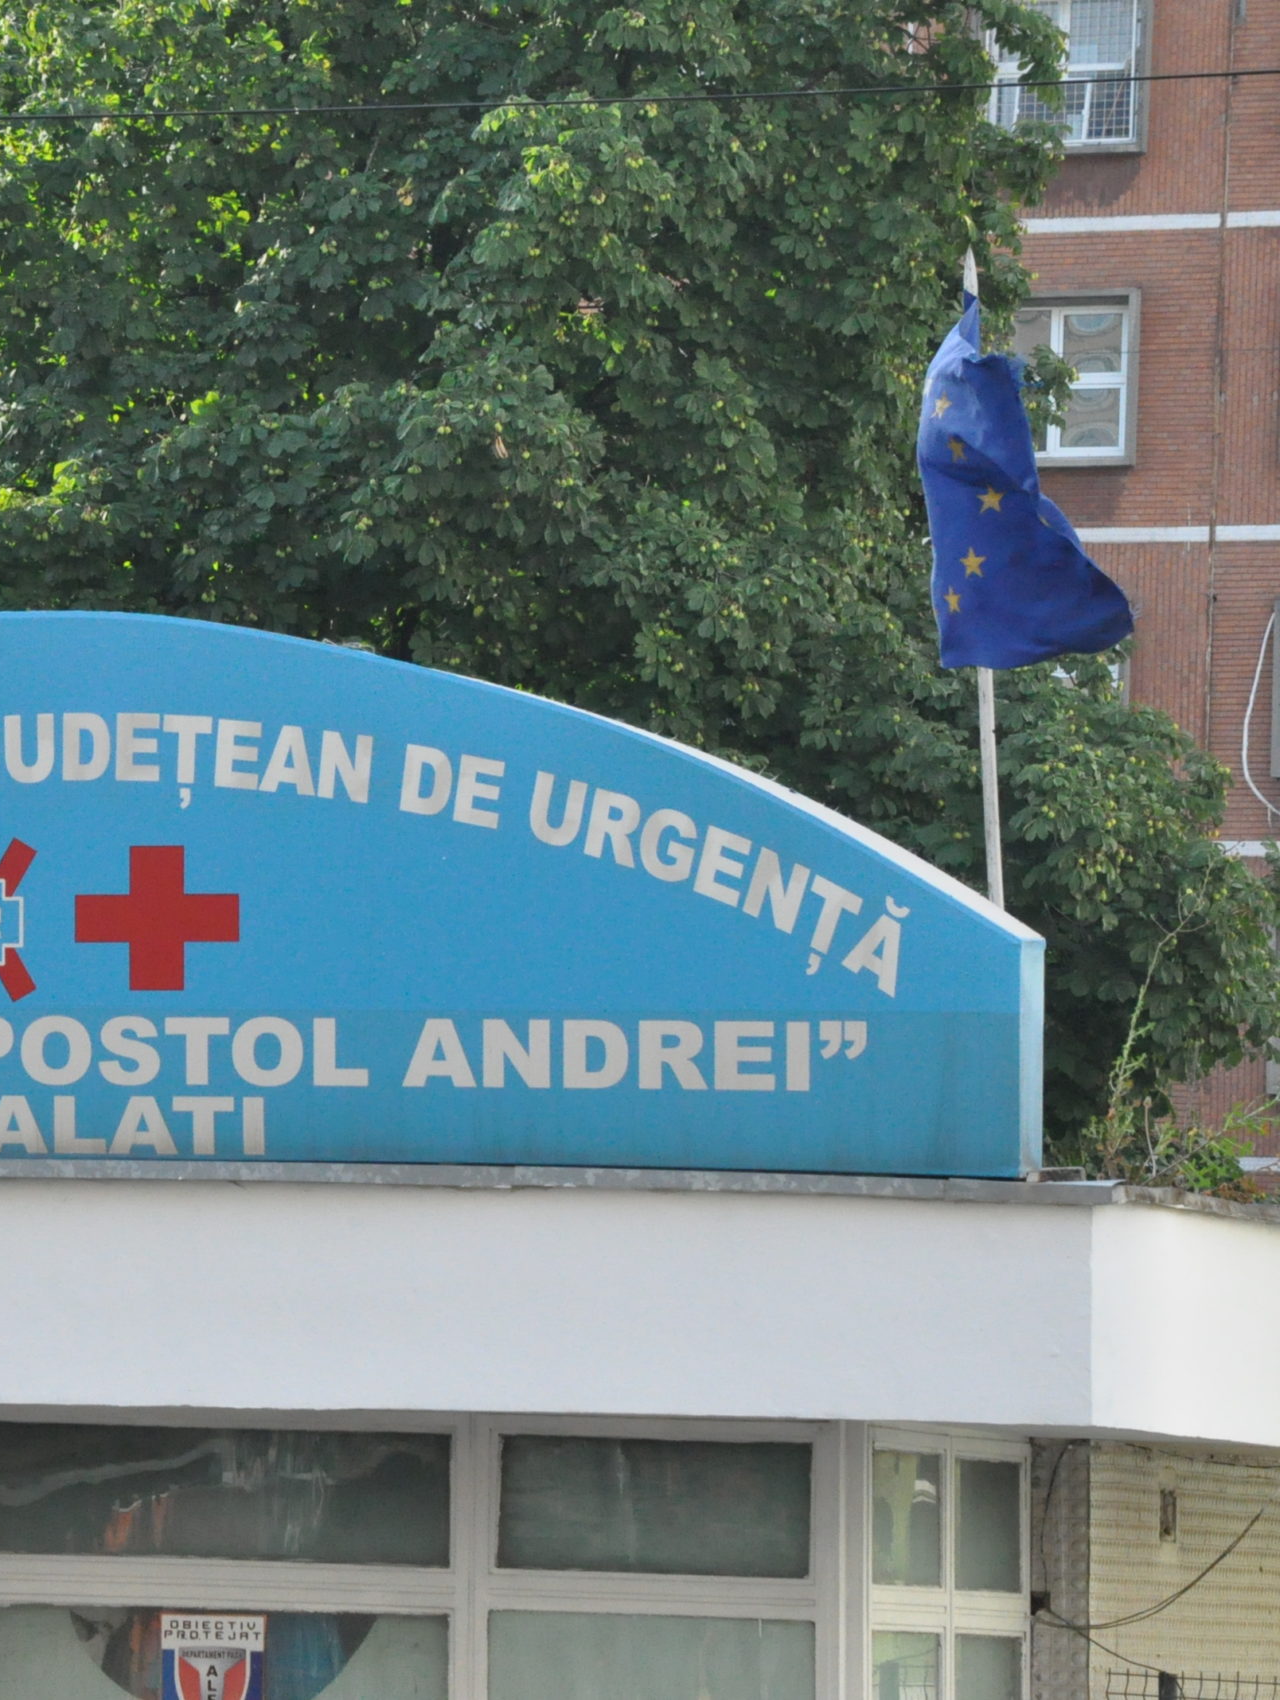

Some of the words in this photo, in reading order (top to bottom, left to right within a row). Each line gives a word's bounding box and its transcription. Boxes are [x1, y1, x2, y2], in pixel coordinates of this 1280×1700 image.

[400, 743, 506, 829] DE
[529, 770, 911, 998] URGENȚĂ
[170, 1619, 256, 1631] OBIECTIV
[163, 1629, 261, 1641] PROTEJAT
